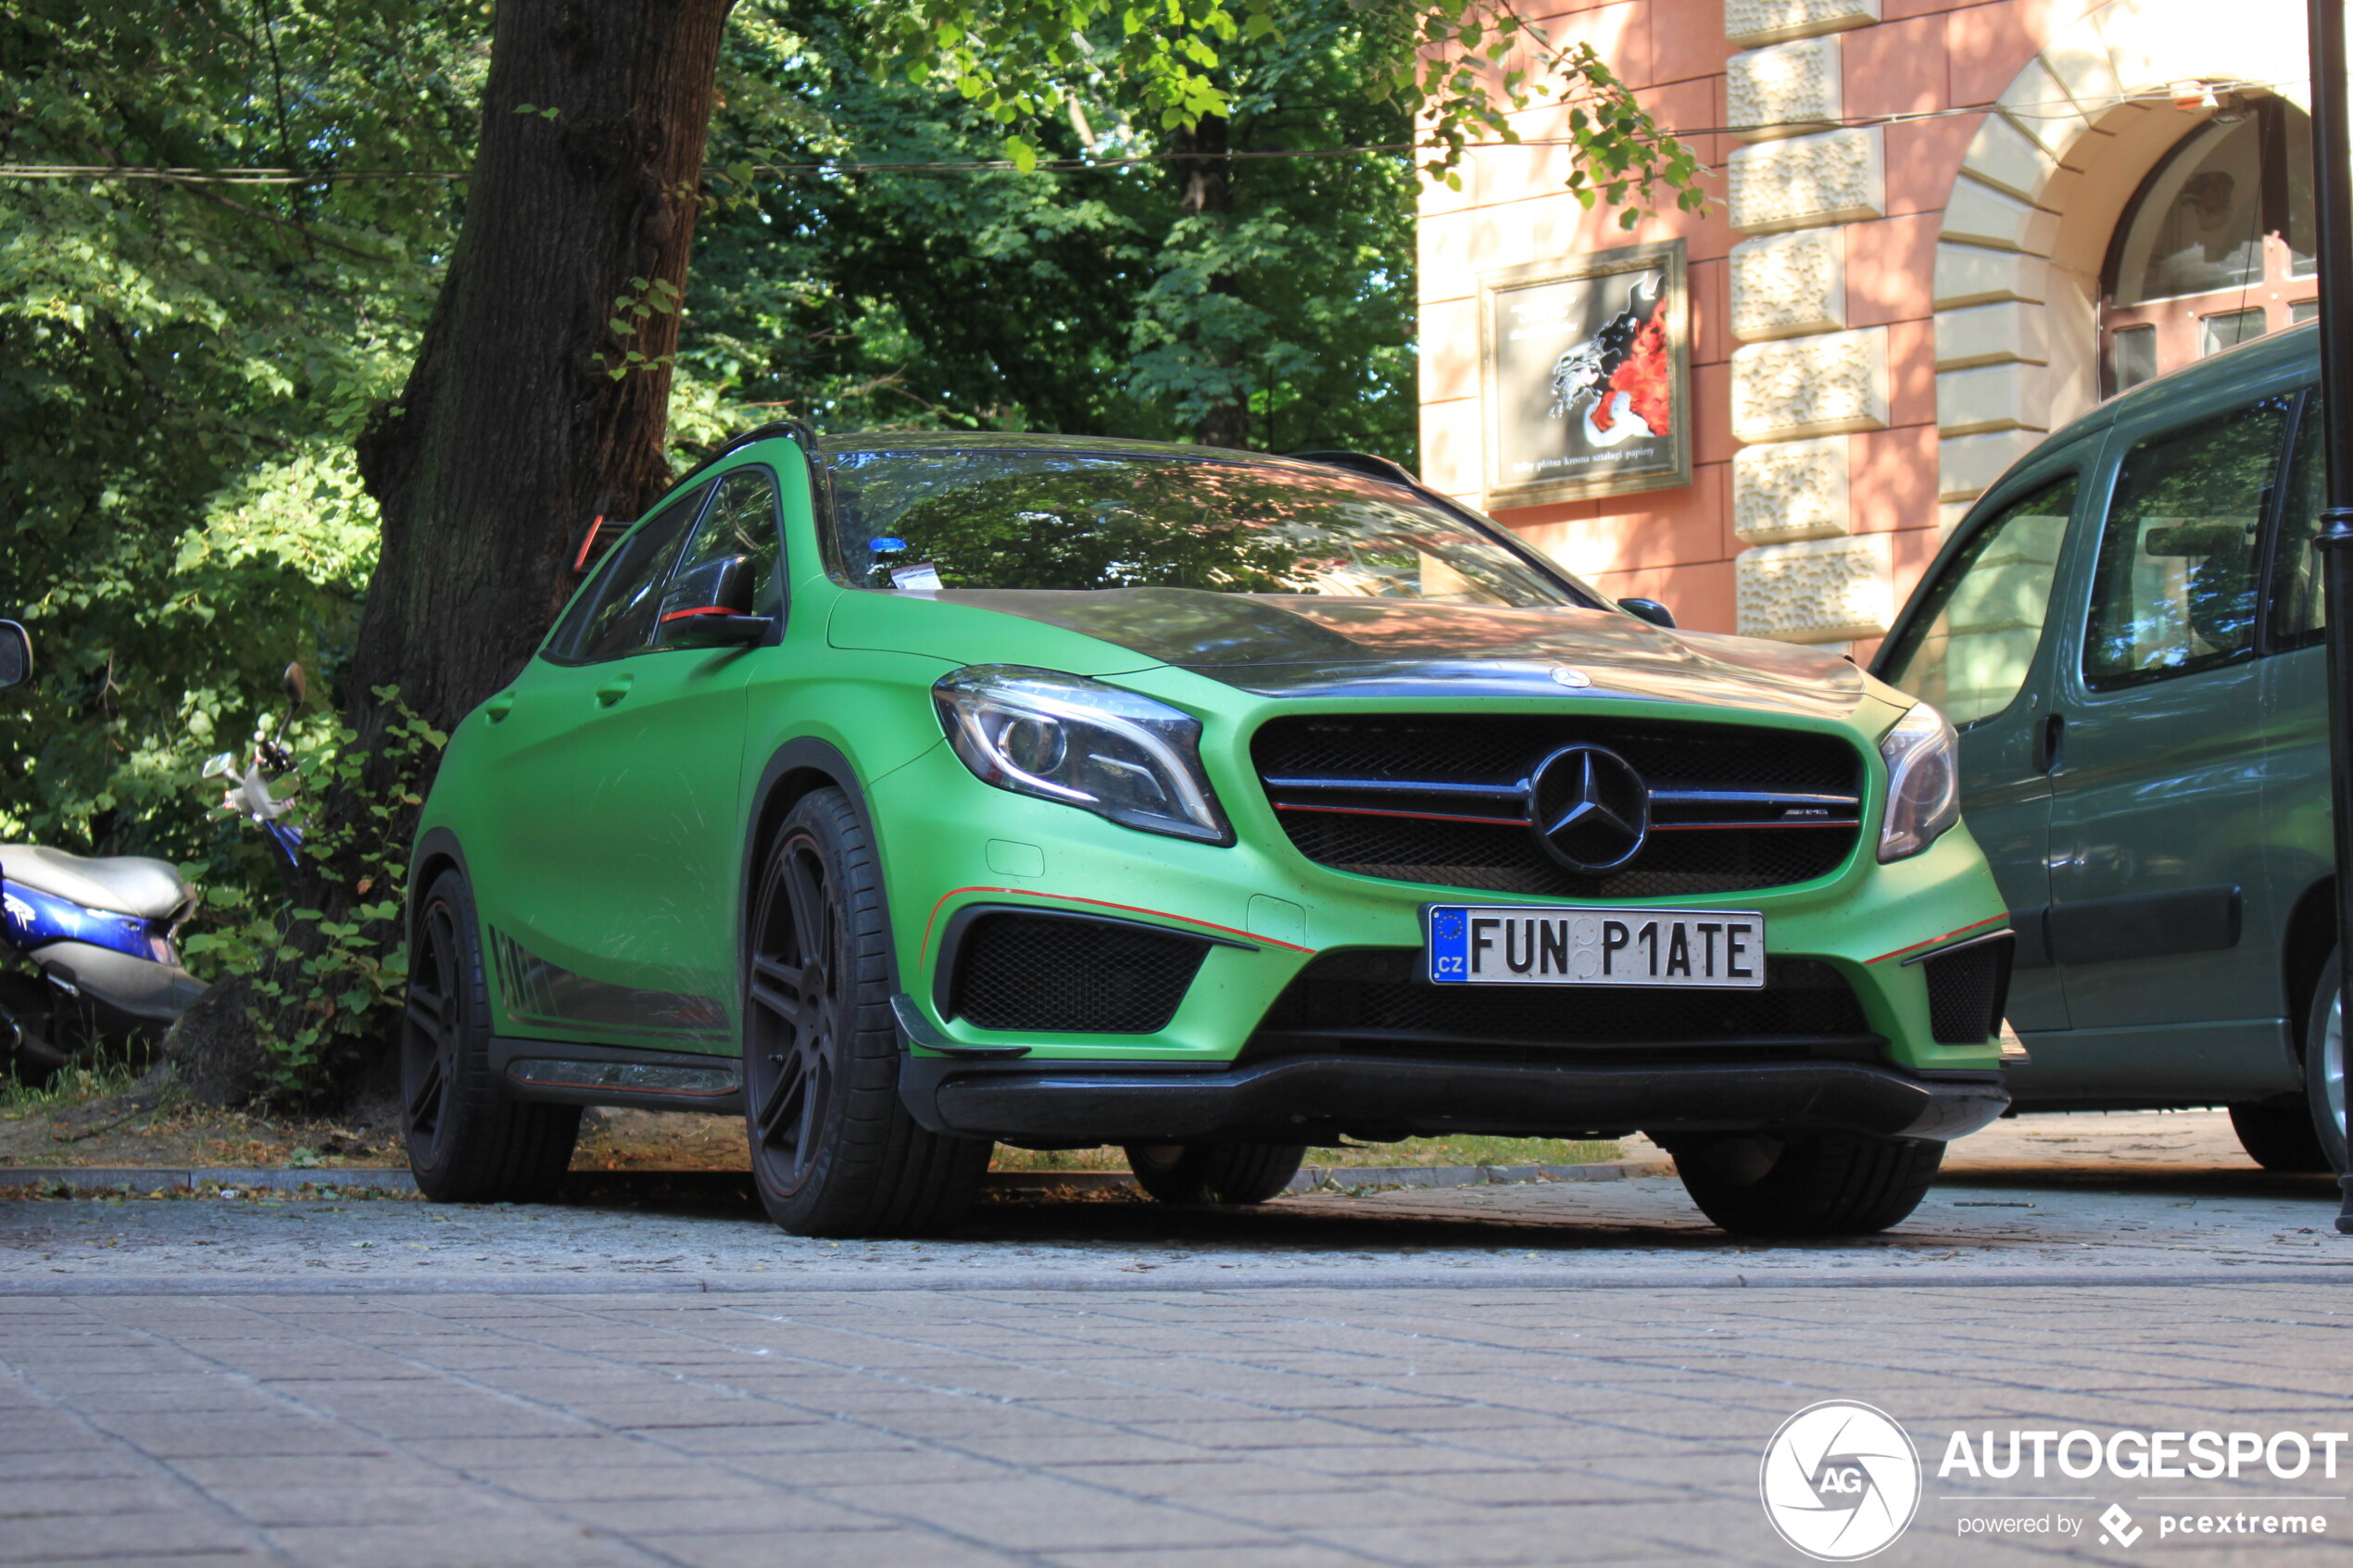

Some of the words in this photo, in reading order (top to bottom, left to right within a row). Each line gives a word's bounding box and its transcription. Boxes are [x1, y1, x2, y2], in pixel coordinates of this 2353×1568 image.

[1438, 956, 1464, 973] CZ
[1471, 918, 1567, 974] FUN
[1603, 920, 1753, 978] P1ATE
